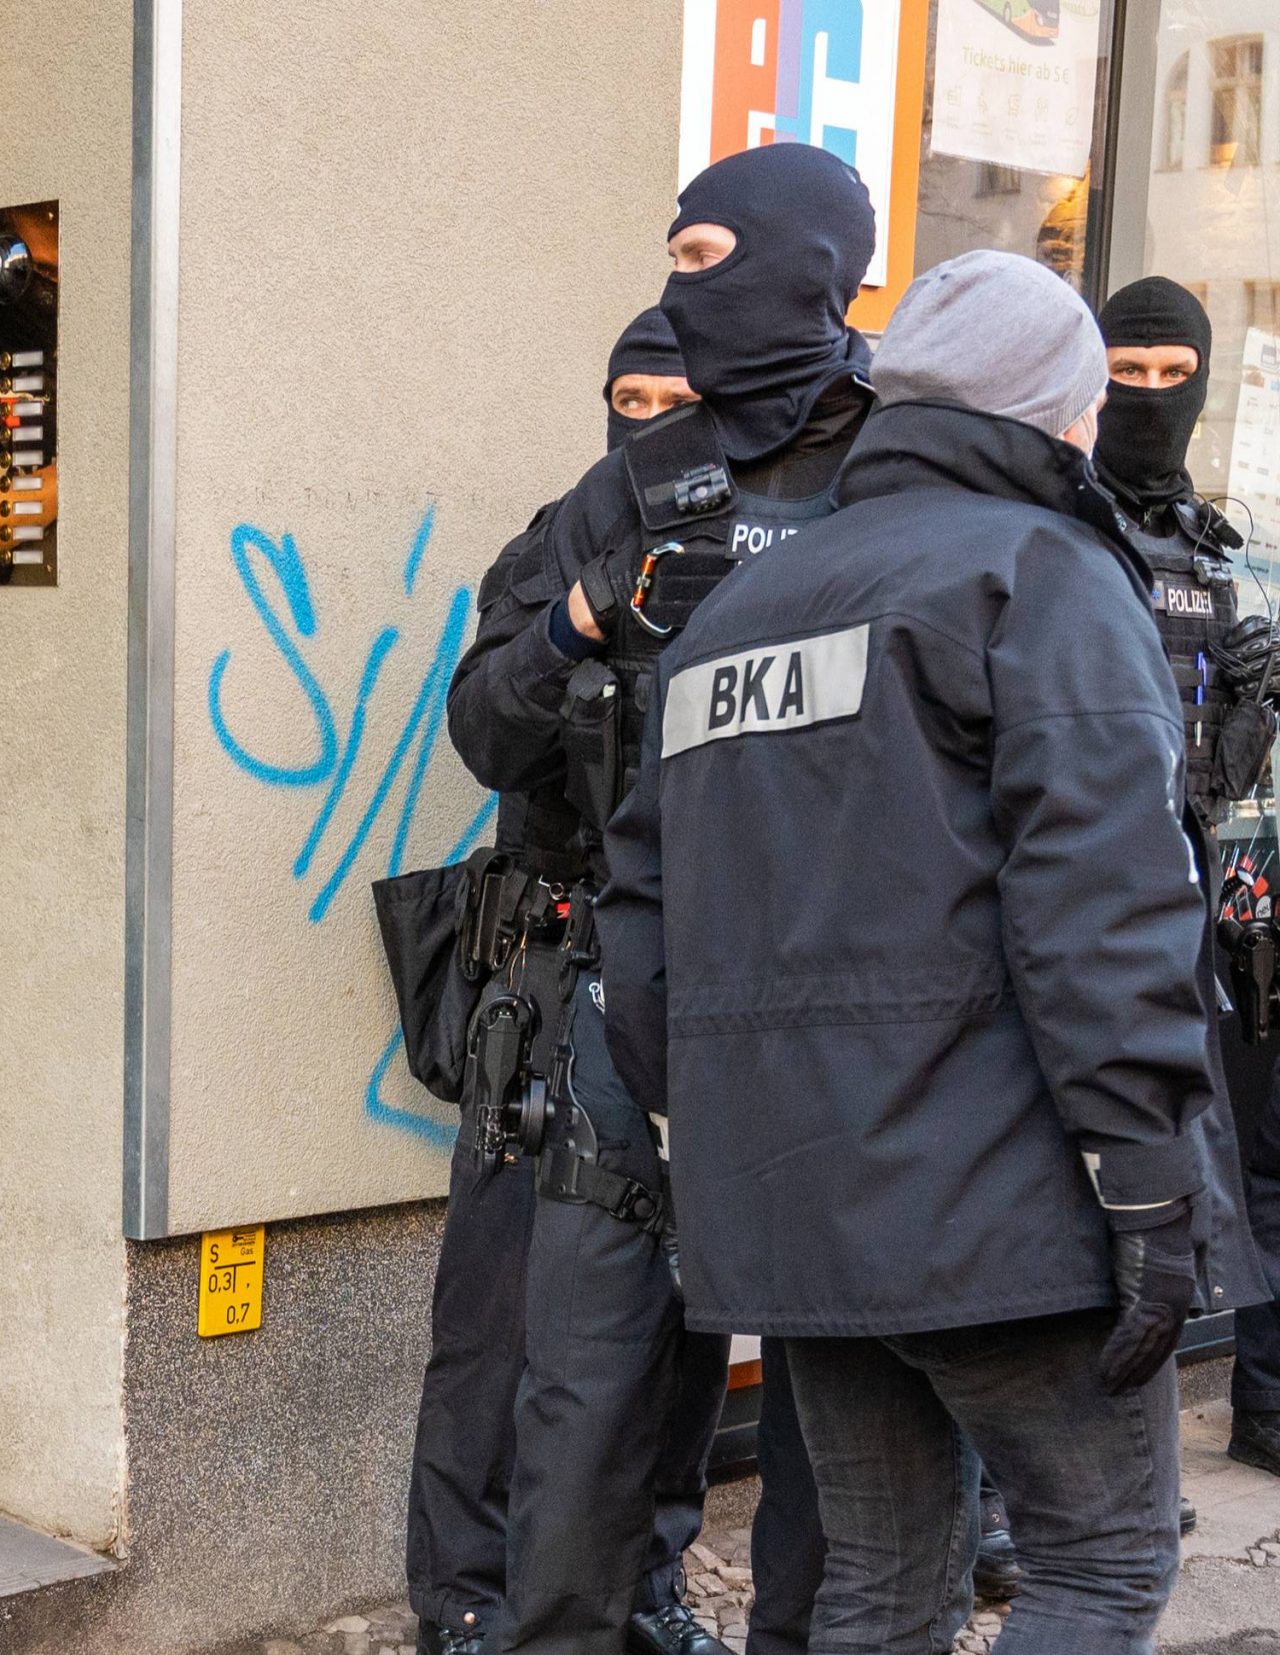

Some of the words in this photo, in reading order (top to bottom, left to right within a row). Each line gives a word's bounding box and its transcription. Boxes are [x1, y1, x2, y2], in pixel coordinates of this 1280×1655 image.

[962, 46, 1006, 72] Tickets
[1009, 54, 1032, 77] hier
[1036, 64, 1051, 80] ab
[1167, 588, 1213, 614] POLIZEI
[708, 651, 804, 731] BKA
[210, 1243, 219, 1263] S
[208, 1271, 232, 1293] 0,3
[226, 1302, 250, 1324] 0,7
